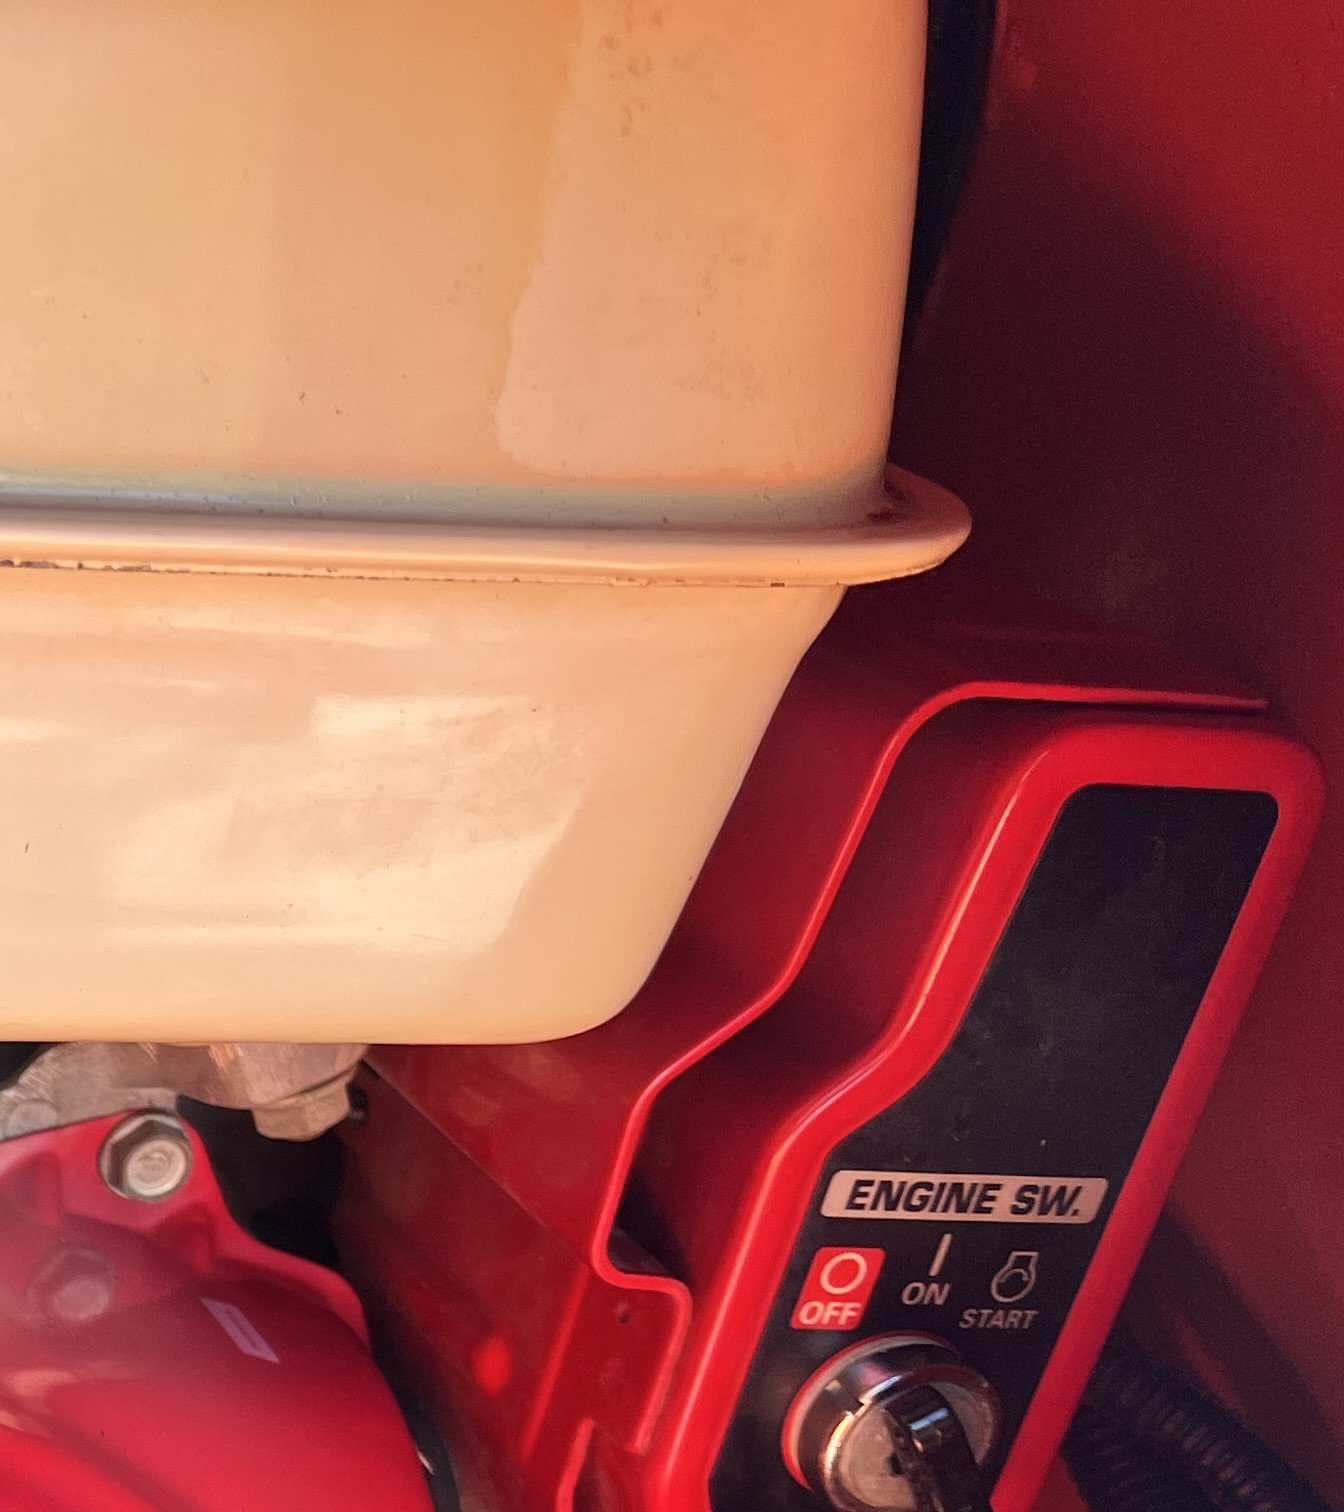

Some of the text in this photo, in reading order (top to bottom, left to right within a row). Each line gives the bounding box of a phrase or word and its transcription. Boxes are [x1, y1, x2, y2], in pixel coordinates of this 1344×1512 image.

[845, 1179, 1083, 1217] ENGINE SW.
[901, 1282, 951, 1305] ON
[799, 1301, 862, 1325] OFF
[959, 1308, 1038, 1329] START
